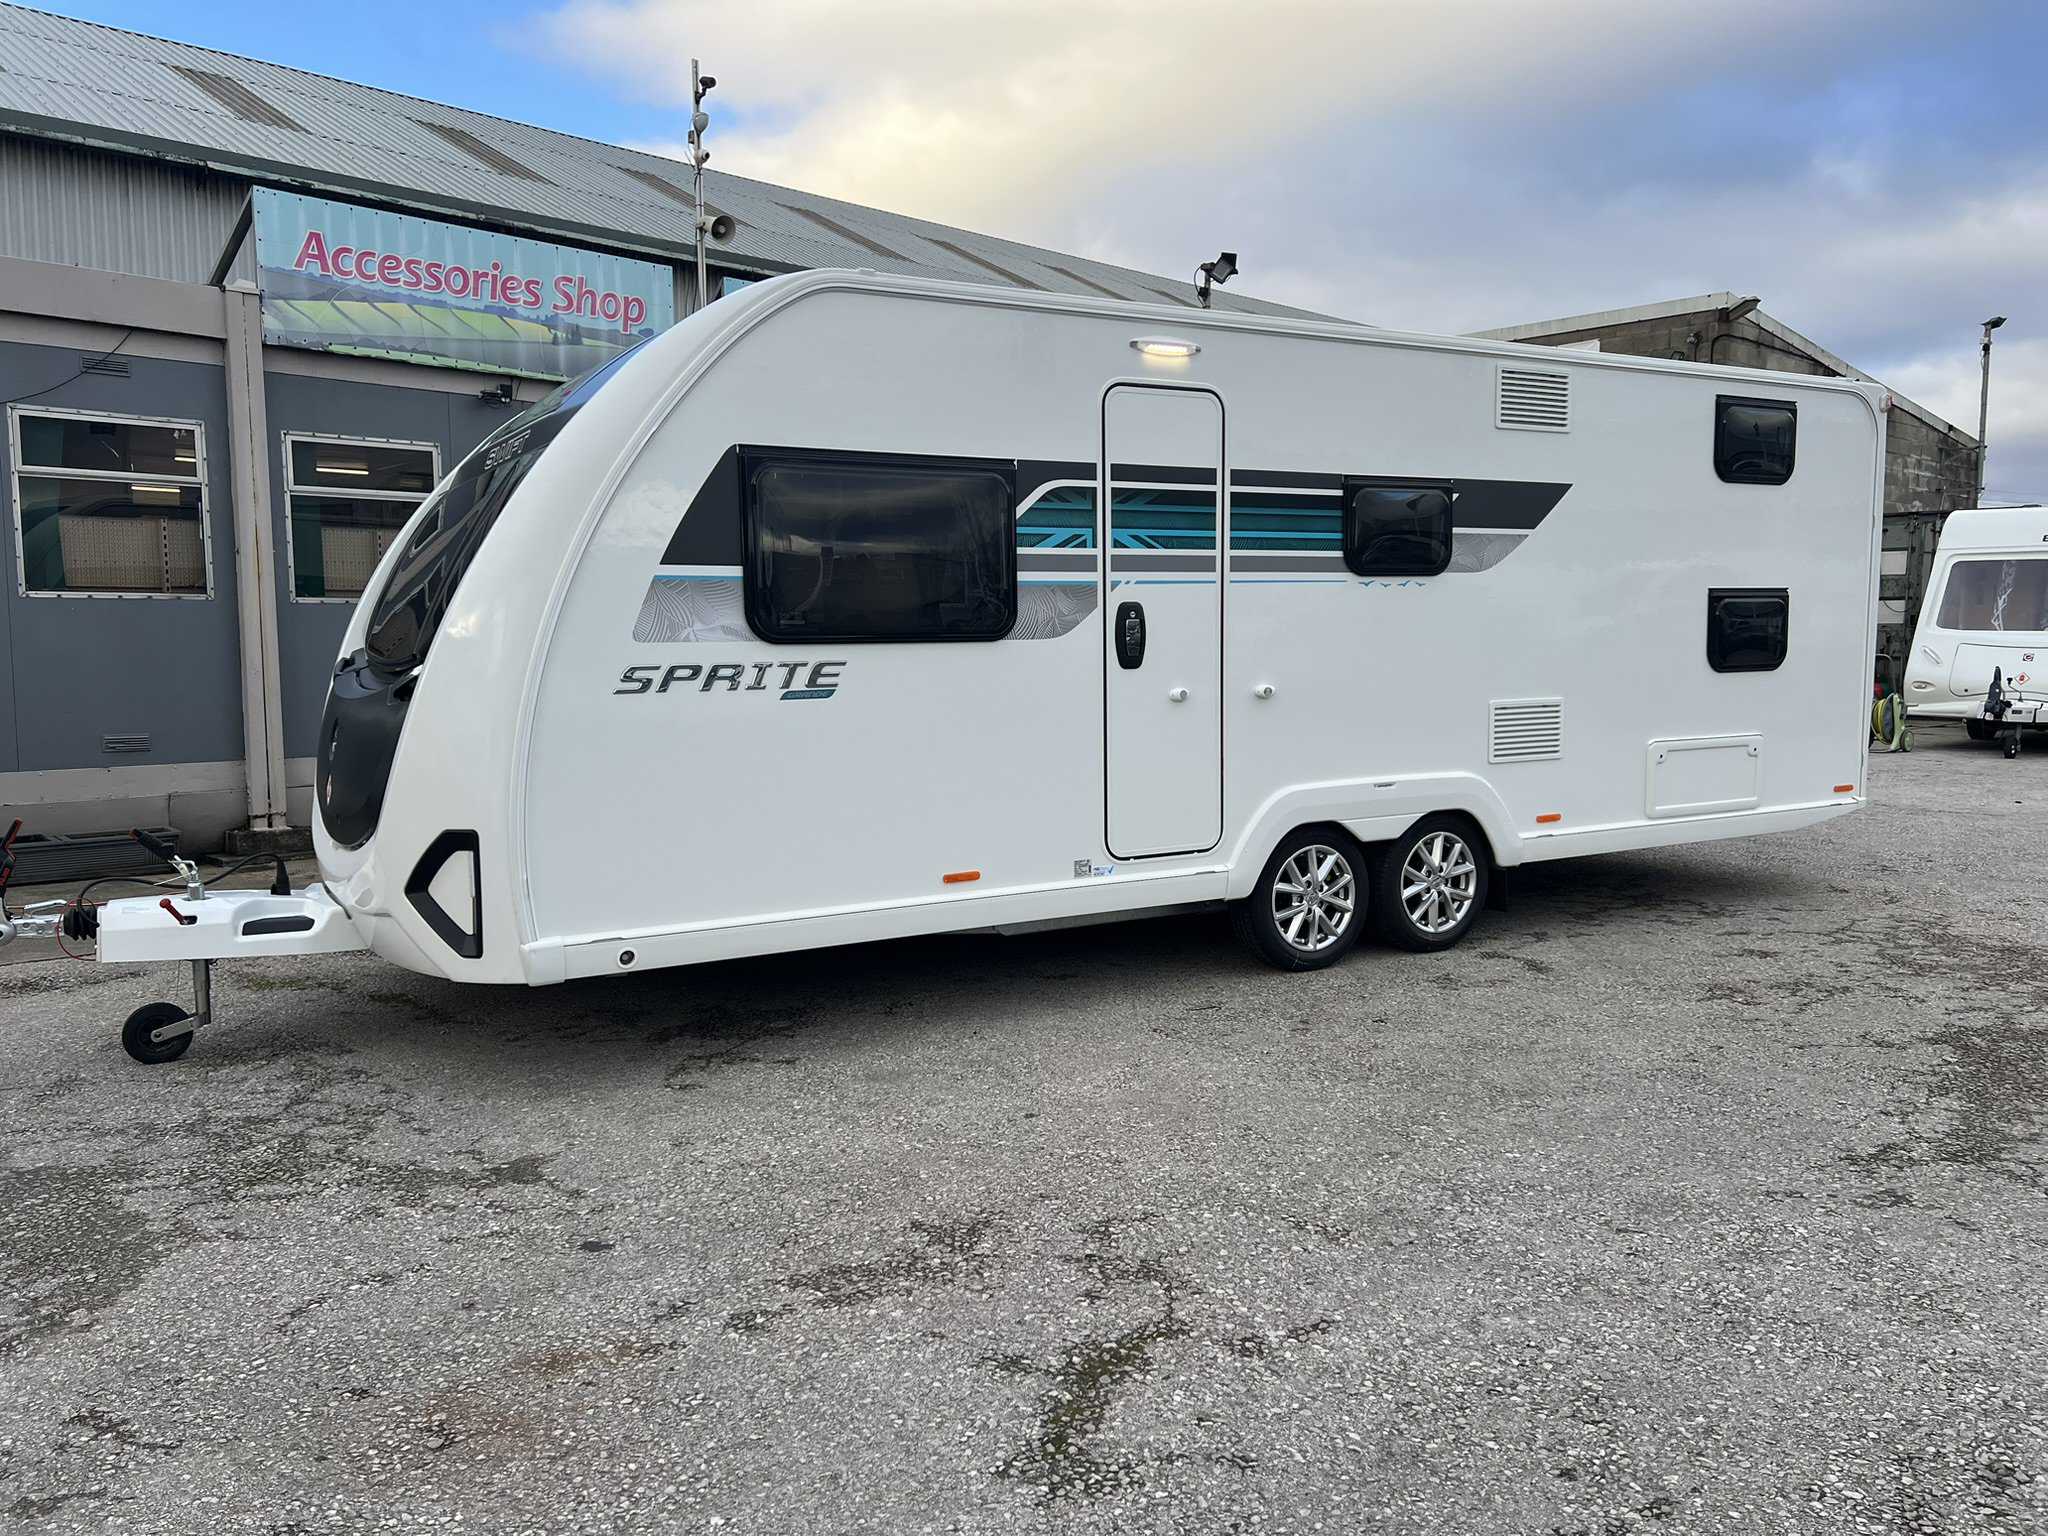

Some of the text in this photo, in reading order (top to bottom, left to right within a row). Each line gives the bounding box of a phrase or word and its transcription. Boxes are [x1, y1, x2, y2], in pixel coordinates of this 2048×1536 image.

[294, 230, 646, 334] Accessories Shop
[613, 661, 847, 694] SPRITE
